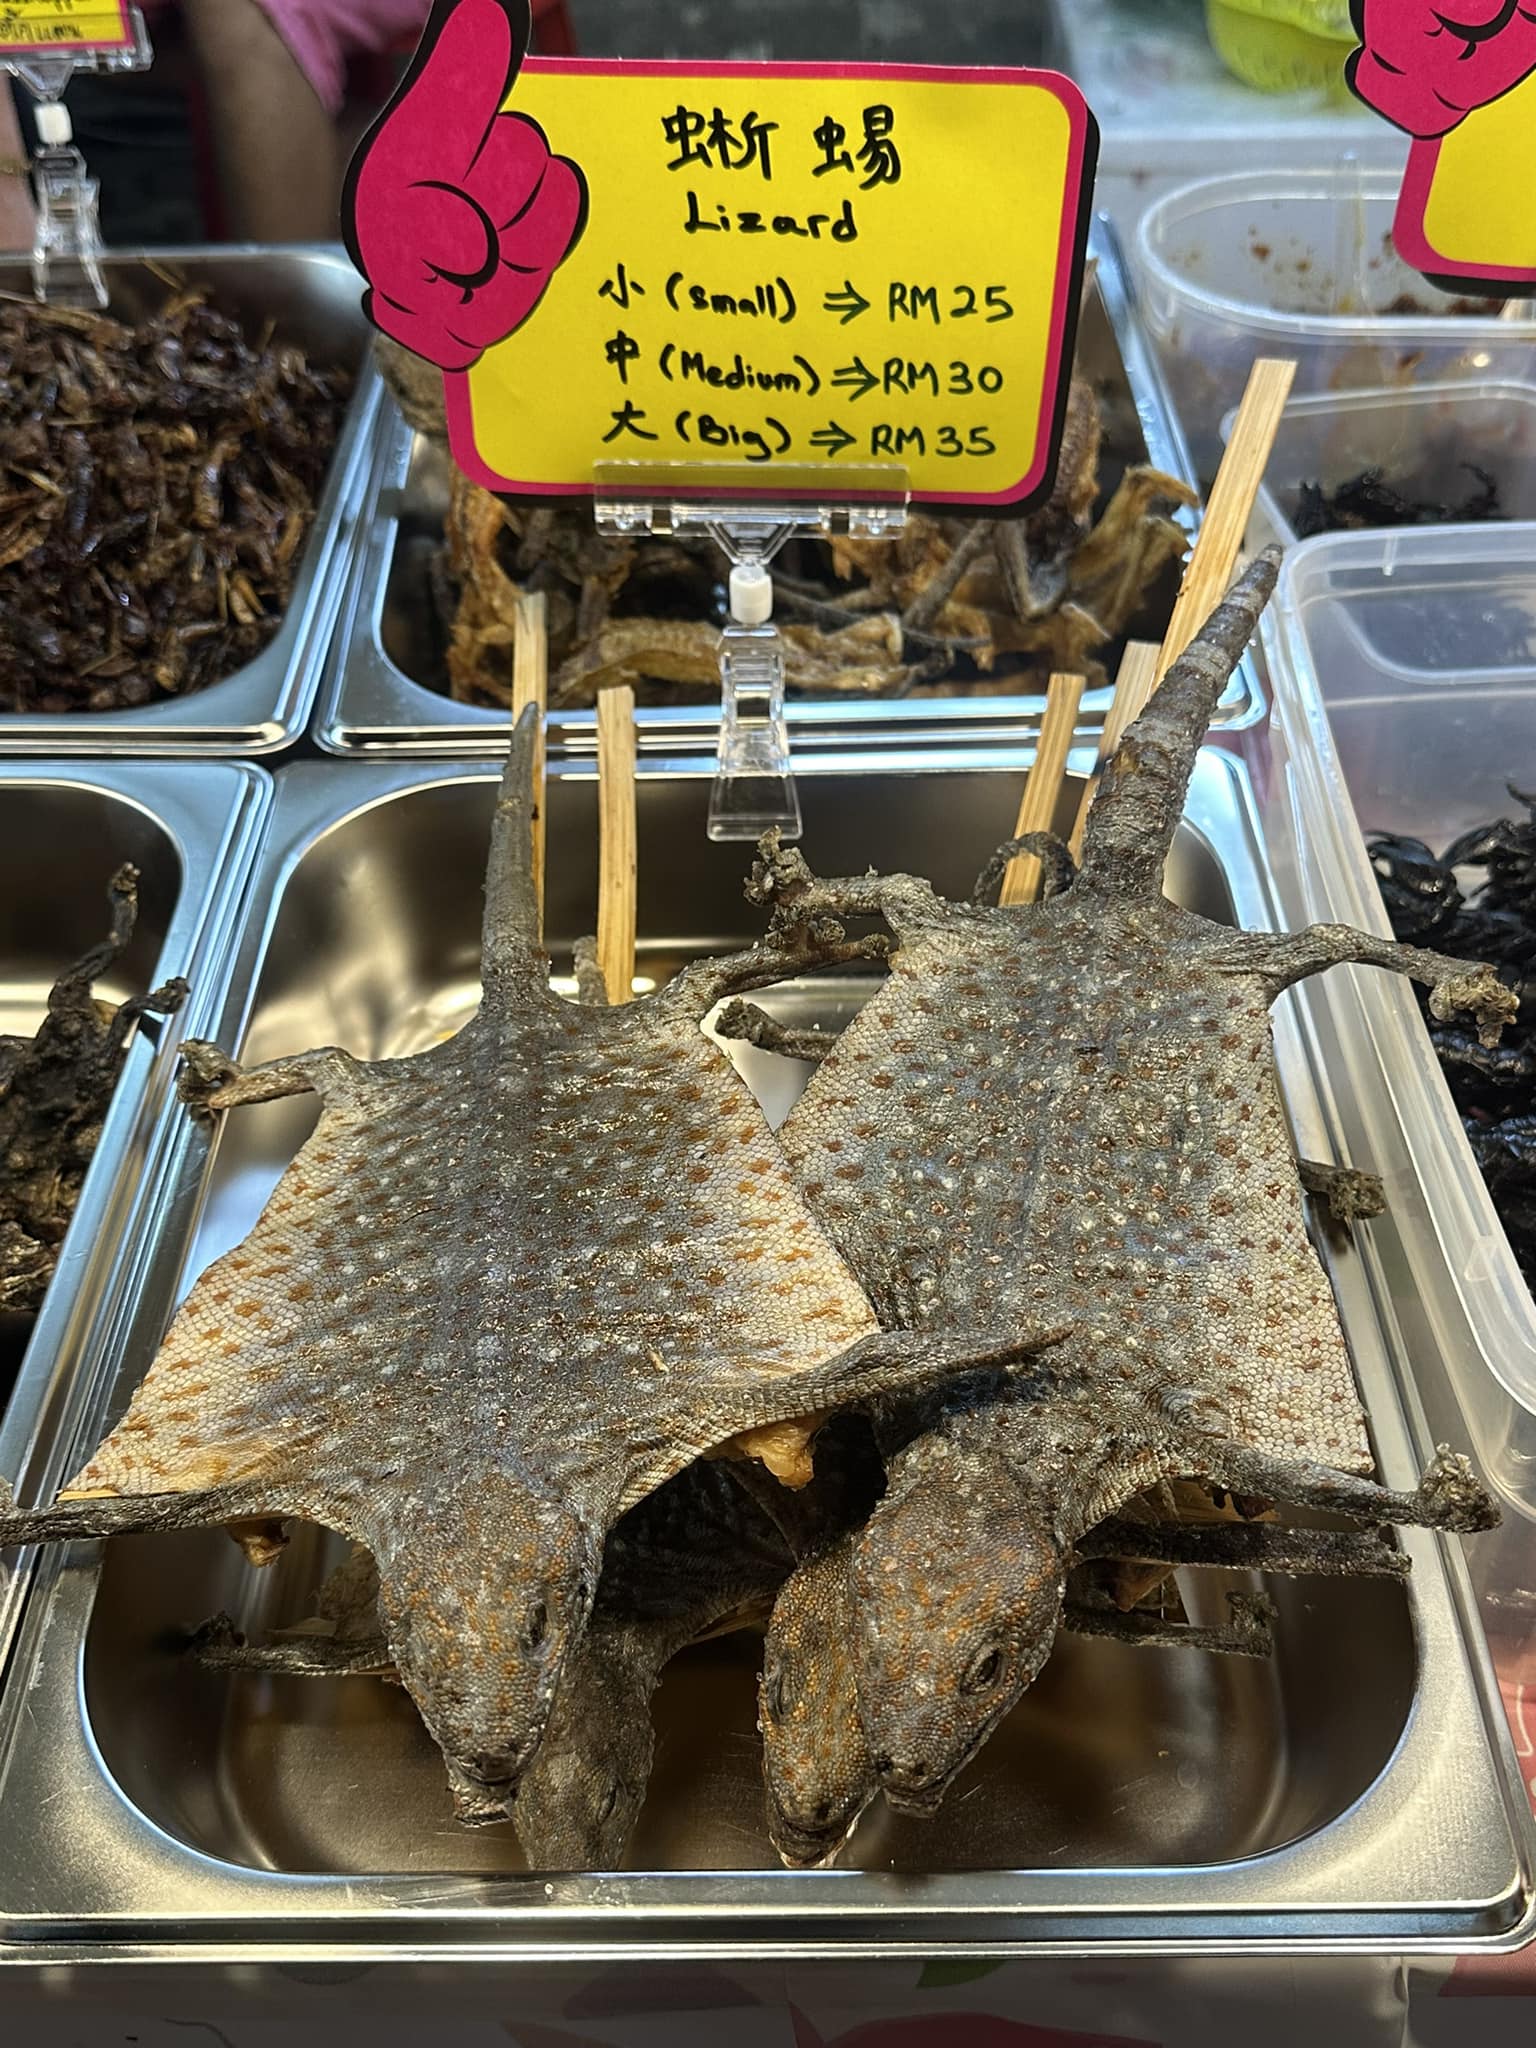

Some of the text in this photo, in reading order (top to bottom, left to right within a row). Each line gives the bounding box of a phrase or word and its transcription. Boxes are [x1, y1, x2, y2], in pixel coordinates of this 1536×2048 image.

[684, 191, 859, 242] Lizard
[598, 263, 646, 309] 小
[605, 330, 640, 384] 中
[658, 343, 821, 396] (Medium)
[602, 400, 659, 443] 大
[674, 410, 792, 462] (Big)
